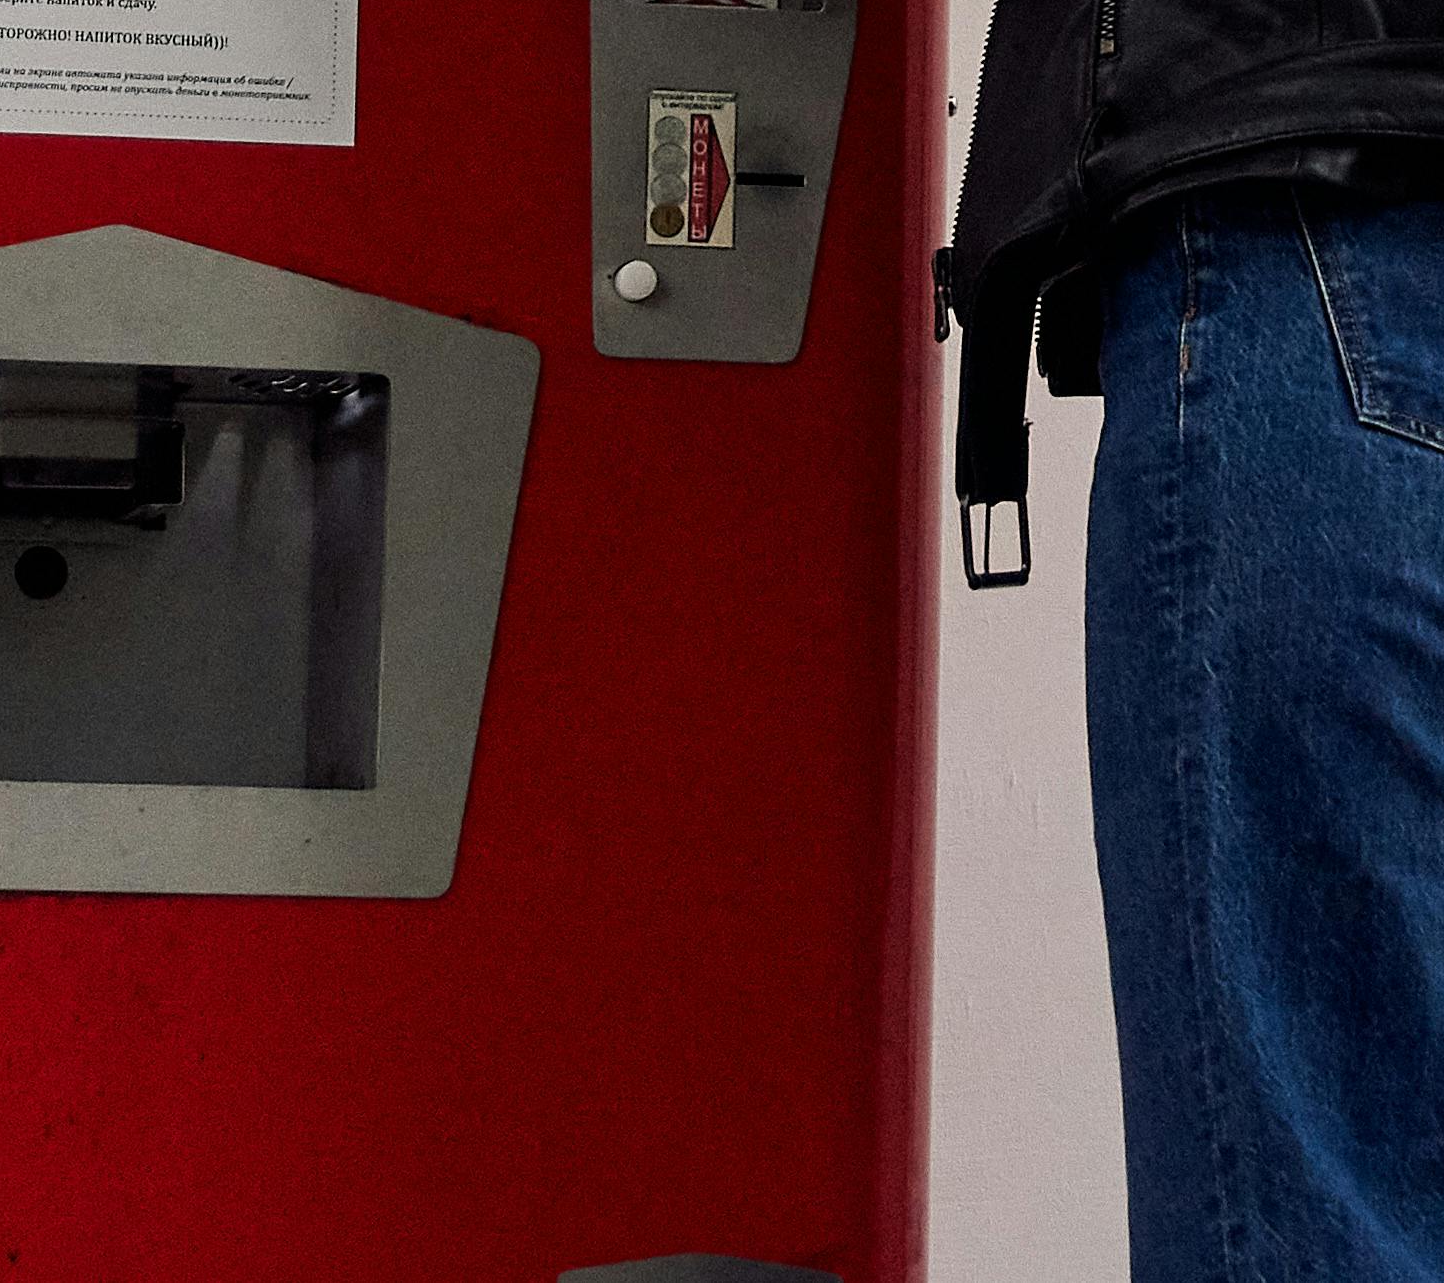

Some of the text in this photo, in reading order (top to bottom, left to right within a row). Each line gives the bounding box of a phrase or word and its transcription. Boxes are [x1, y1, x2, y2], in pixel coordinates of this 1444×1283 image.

[75, 30, 142, 45] НАПИТОК
[145, 32, 229, 51] ВКУСНЫЙ))!
[13, 67, 26, 76] на
[27, 67, 63, 79] экране
[64, 69, 122, 80] автомата
[123, 71, 165, 83] указана
[166, 72, 232, 86] информация
[233, 74, 247, 85] об
[70, 83, 108, 94] просим
[110, 85, 122, 94] не
[124, 85, 174, 96] опускать
[175, 86, 210, 98] деньги
[692, 118, 710, 240] МОНЕТЫ
